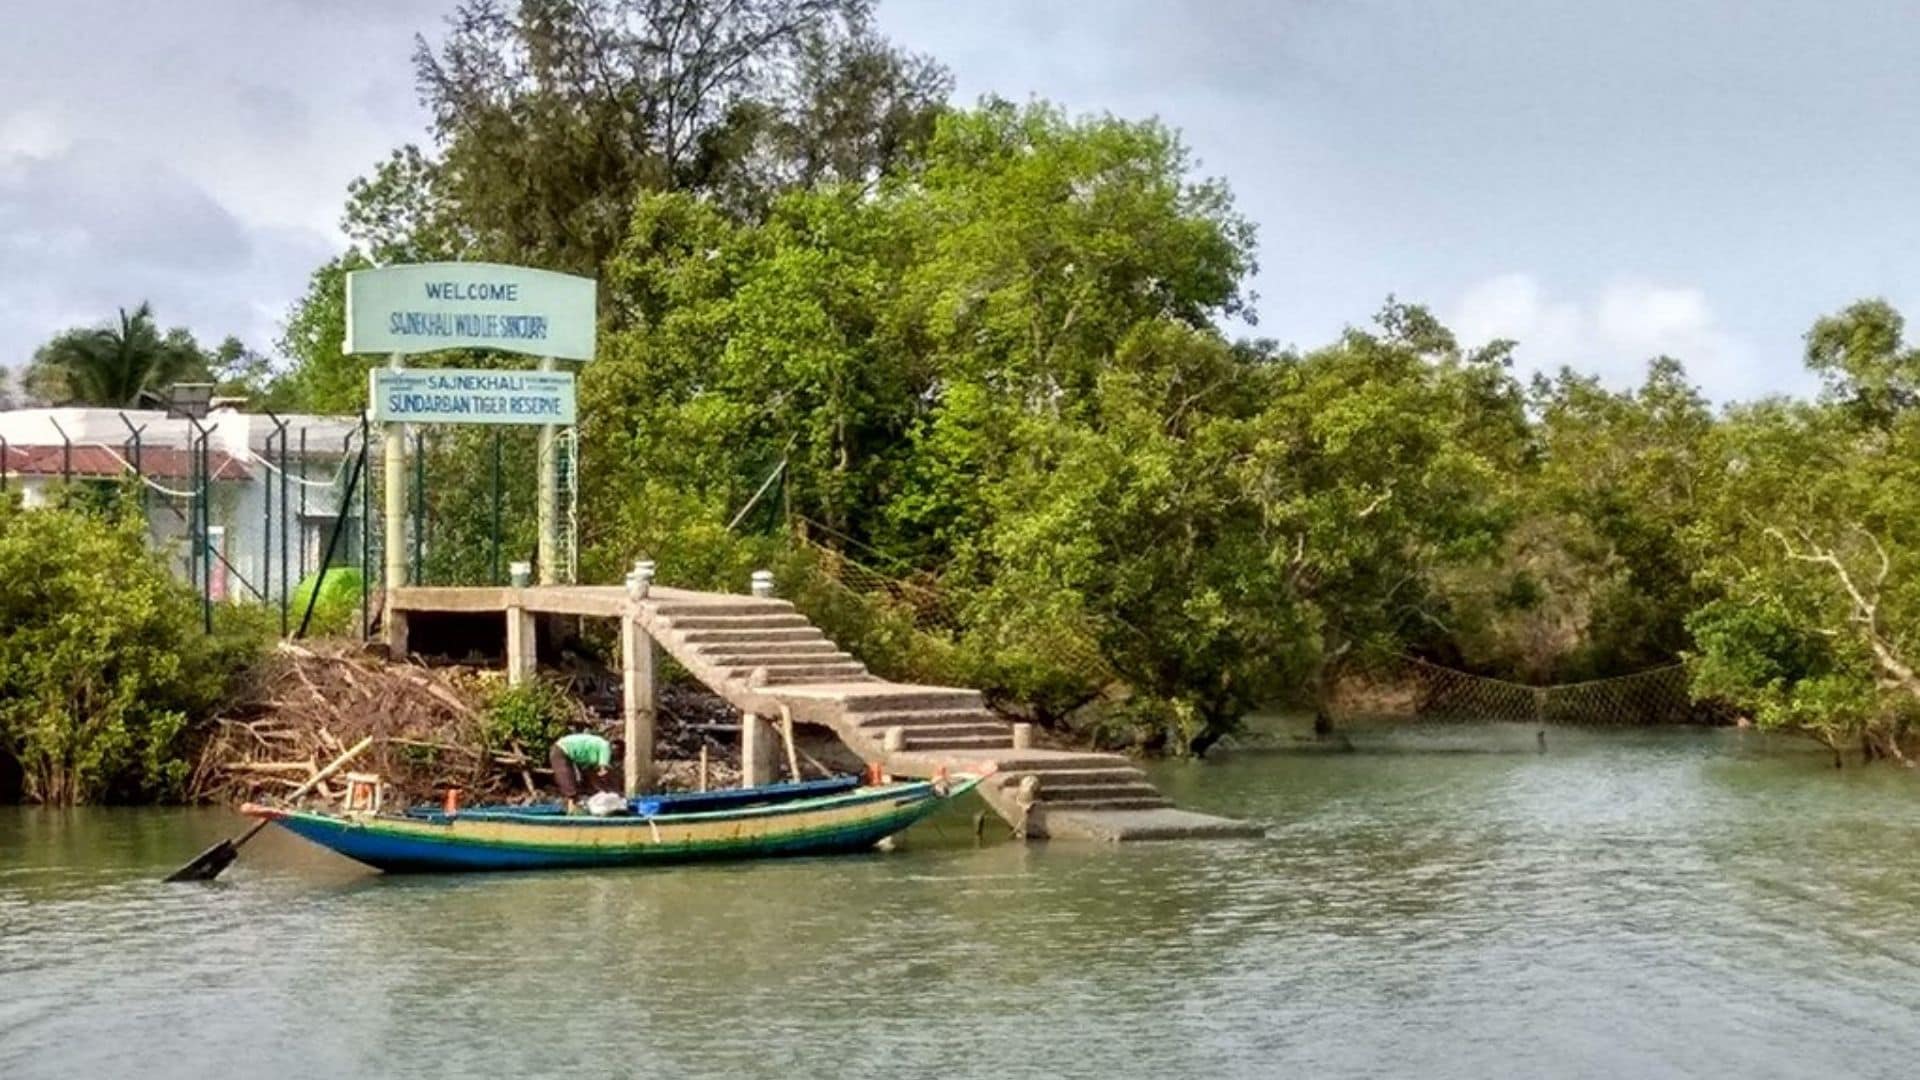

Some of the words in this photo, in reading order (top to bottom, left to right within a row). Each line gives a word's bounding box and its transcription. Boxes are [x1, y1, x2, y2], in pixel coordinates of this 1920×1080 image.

[426, 283, 518, 300] WELCOME
[391, 311, 450, 336] SAJNEKHALI
[427, 376, 524, 391] SAJNEKHALI
[389, 394, 470, 414] SUNDARBAN
[471, 396, 507, 414] TIGER
[510, 397, 561, 415] RESERVE
